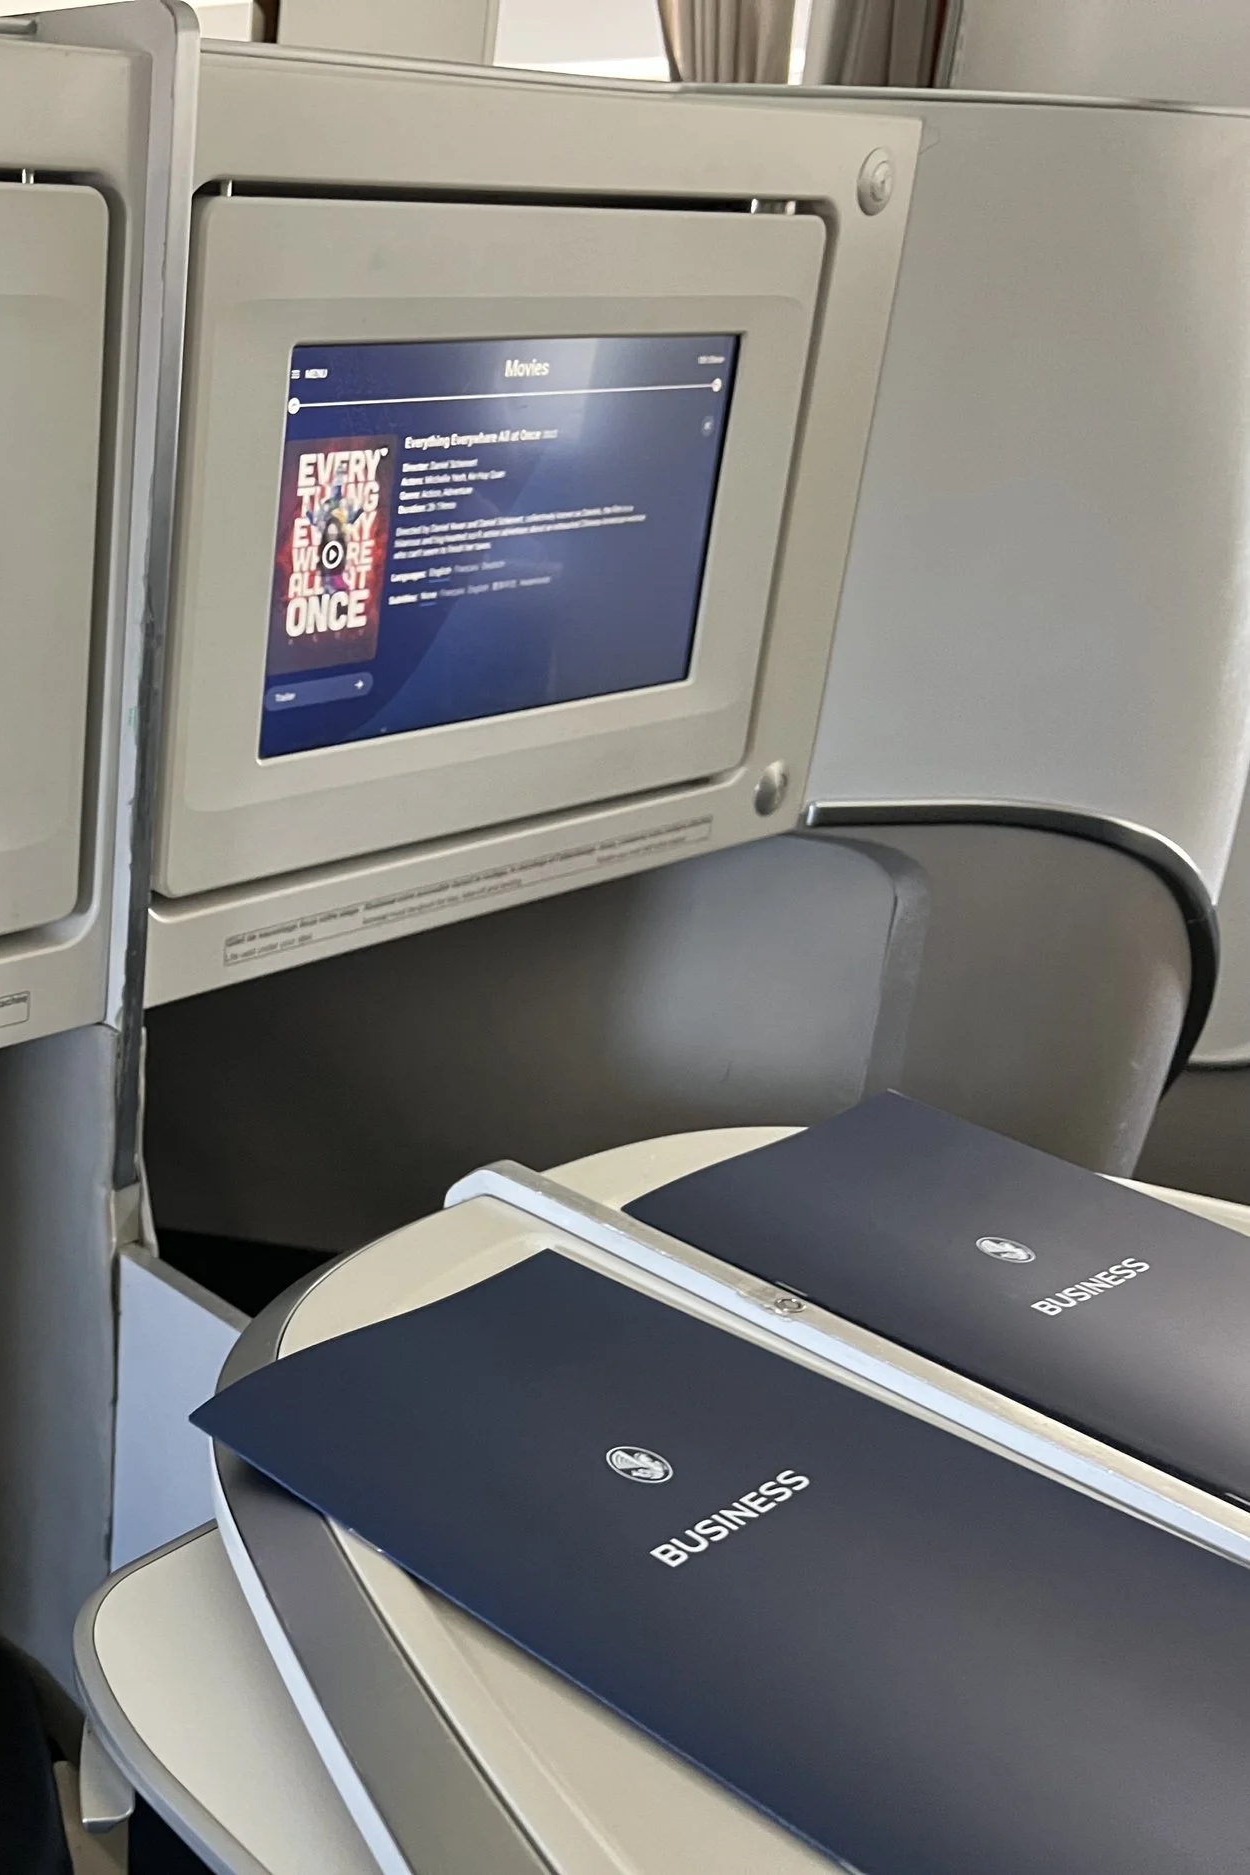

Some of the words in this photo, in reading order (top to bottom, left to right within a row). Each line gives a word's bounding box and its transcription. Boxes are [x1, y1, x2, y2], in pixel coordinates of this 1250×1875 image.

[504, 360, 549, 378] Movies
[405, 435, 450, 450] Everything
[451, 432, 498, 448] Everywhere
[498, 430, 511, 442] All
[286, 589, 369, 637] ONCE
[1030, 1257, 1151, 1318] BUSINESS
[650, 1470, 811, 1569] BUSINESS
